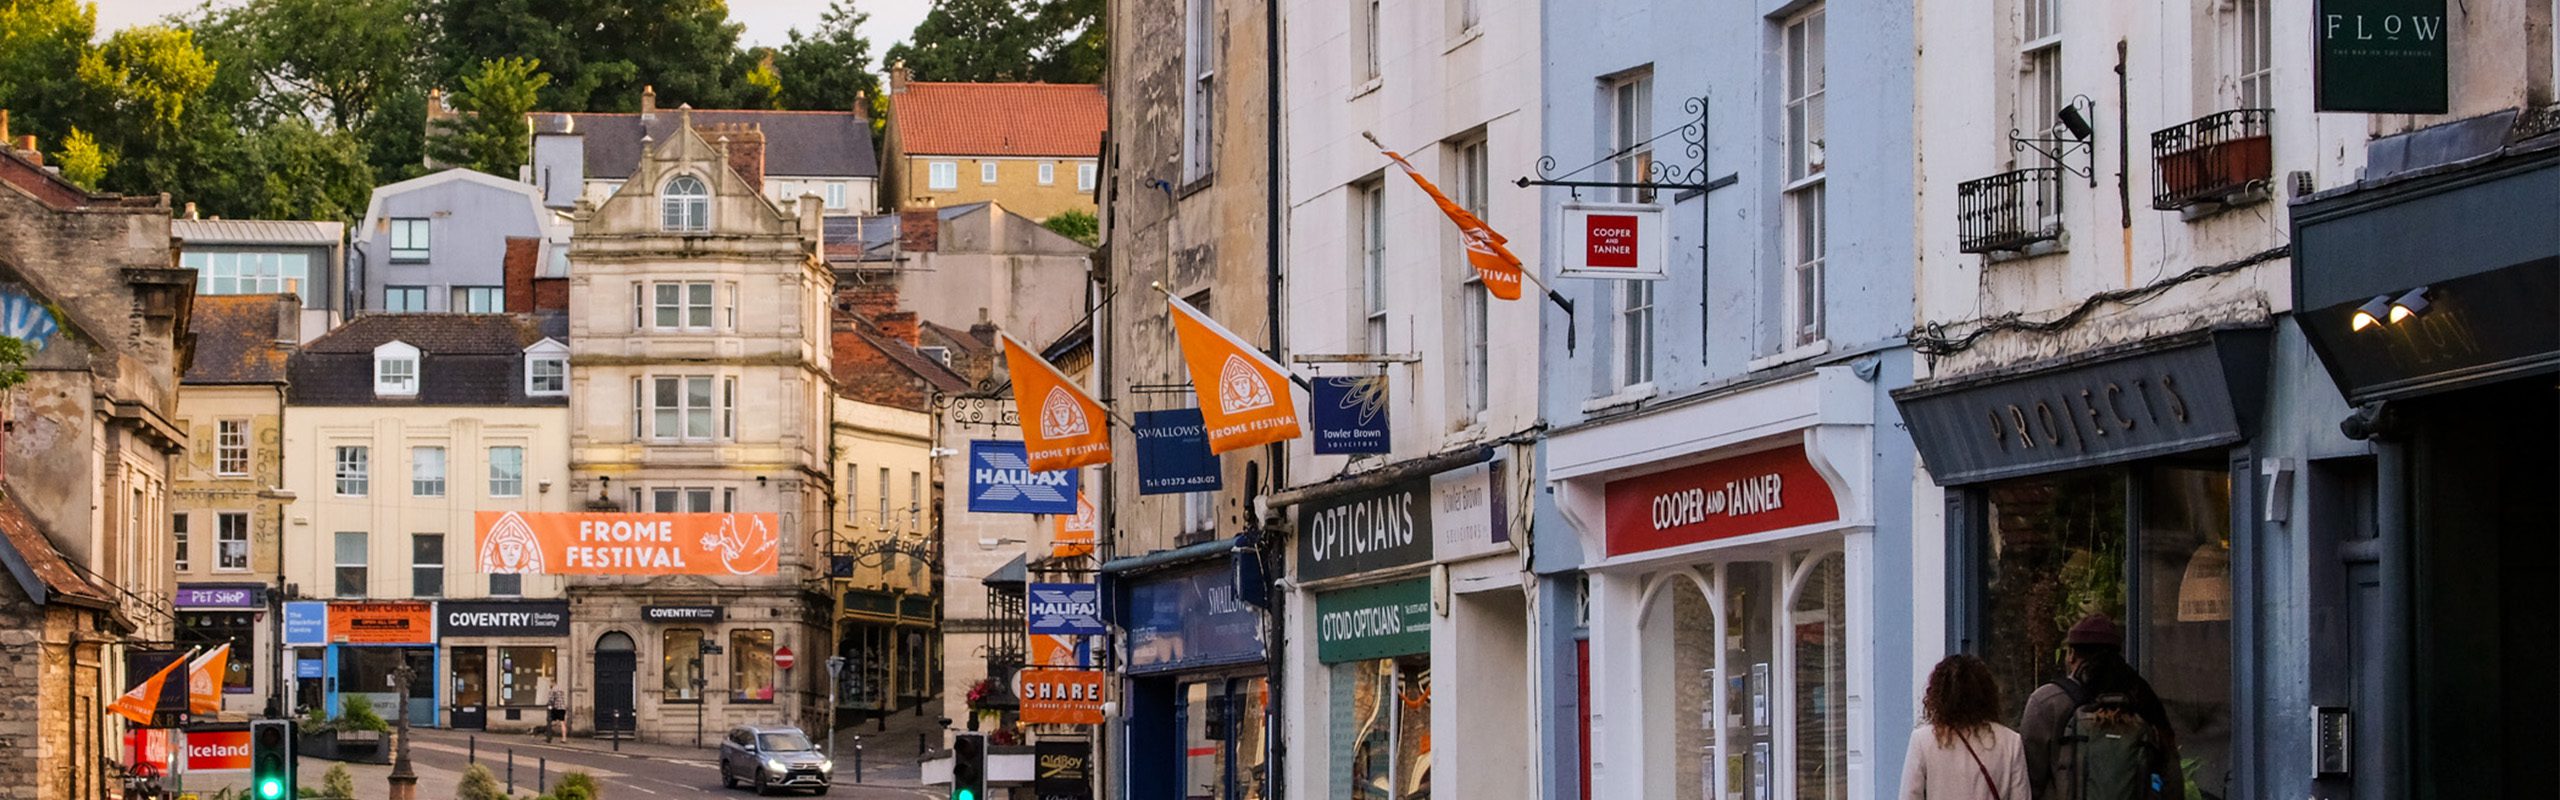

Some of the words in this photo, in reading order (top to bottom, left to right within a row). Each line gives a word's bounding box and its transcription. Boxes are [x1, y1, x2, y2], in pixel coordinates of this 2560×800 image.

[2327, 14, 2440, 40] FLOW
[1593, 228, 1631, 238] COOPER
[1593, 245, 1631, 255] TANNER
[1476, 267, 1519, 283] STIVAL
[1988, 374, 2189, 452] PROJECTS
[1138, 425, 1200, 439] SWALLOWS
[1210, 423, 1248, 440] FROME
[1323, 429, 1351, 439] Towler
[1353, 429, 1382, 439] Brown
[1030, 450, 1063, 460] FROME
[1065, 442, 1110, 456] FESTIVAL
[976, 468, 1069, 486] HALIFAX
[1161, 477, 1186, 486] 01373
[2262, 457, 2289, 521] 7
[1442, 485, 1461, 514] Towler
[1463, 485, 1483, 510] Brown
[1652, 488, 1705, 530] COOPER
[1706, 490, 1726, 515] AND
[1726, 473, 1782, 517] TANNER
[580, 521, 672, 541] FROME
[1312, 491, 1413, 561] OPTICIANS
[566, 547, 686, 568] FESTIVAL
[192, 591, 213, 603] PET
[449, 612, 531, 626] COVENTRY
[534, 612, 560, 621] Building
[650, 608, 697, 618] COVENTRY
[1322, 610, 1352, 641] O'TOID
[1353, 604, 1401, 638] OPTICIANS
[1024, 682, 1100, 700] SHARE
[188, 743, 250, 757] Iceland
[1040, 754, 1083, 769] OldBoy
